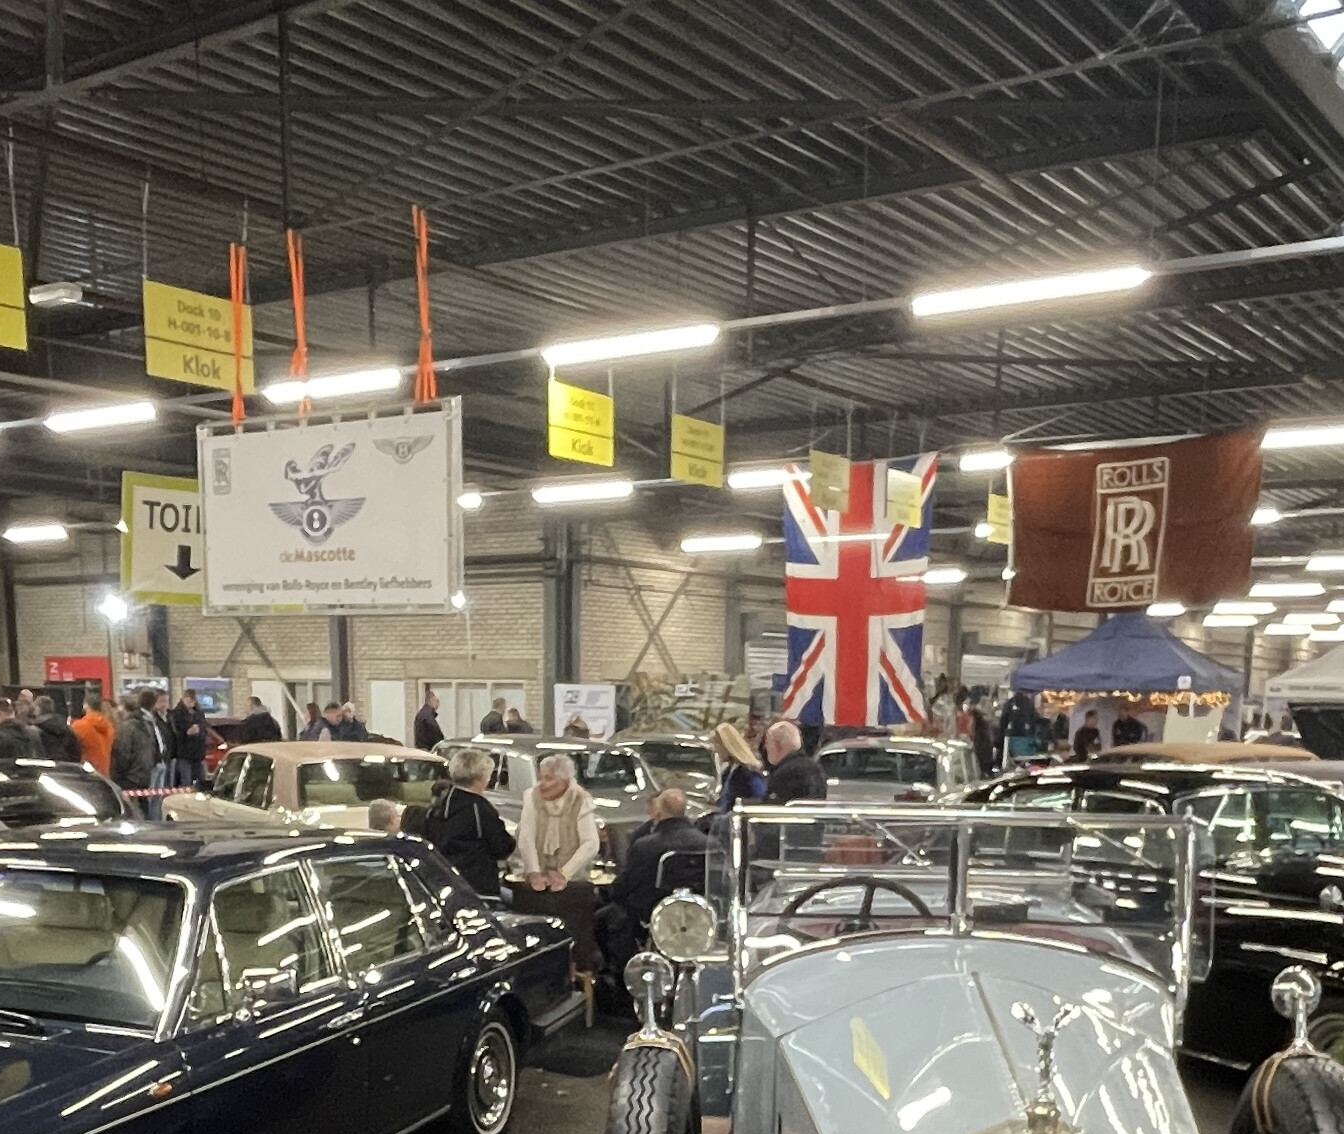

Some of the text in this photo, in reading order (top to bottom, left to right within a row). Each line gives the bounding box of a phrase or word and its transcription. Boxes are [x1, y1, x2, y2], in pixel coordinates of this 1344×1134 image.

[182, 354, 221, 380] Klok
[1102, 462, 1164, 488] ROLLS
[344, 577, 377, 592] Bentley
[1093, 580, 1153, 603] ROYCE
